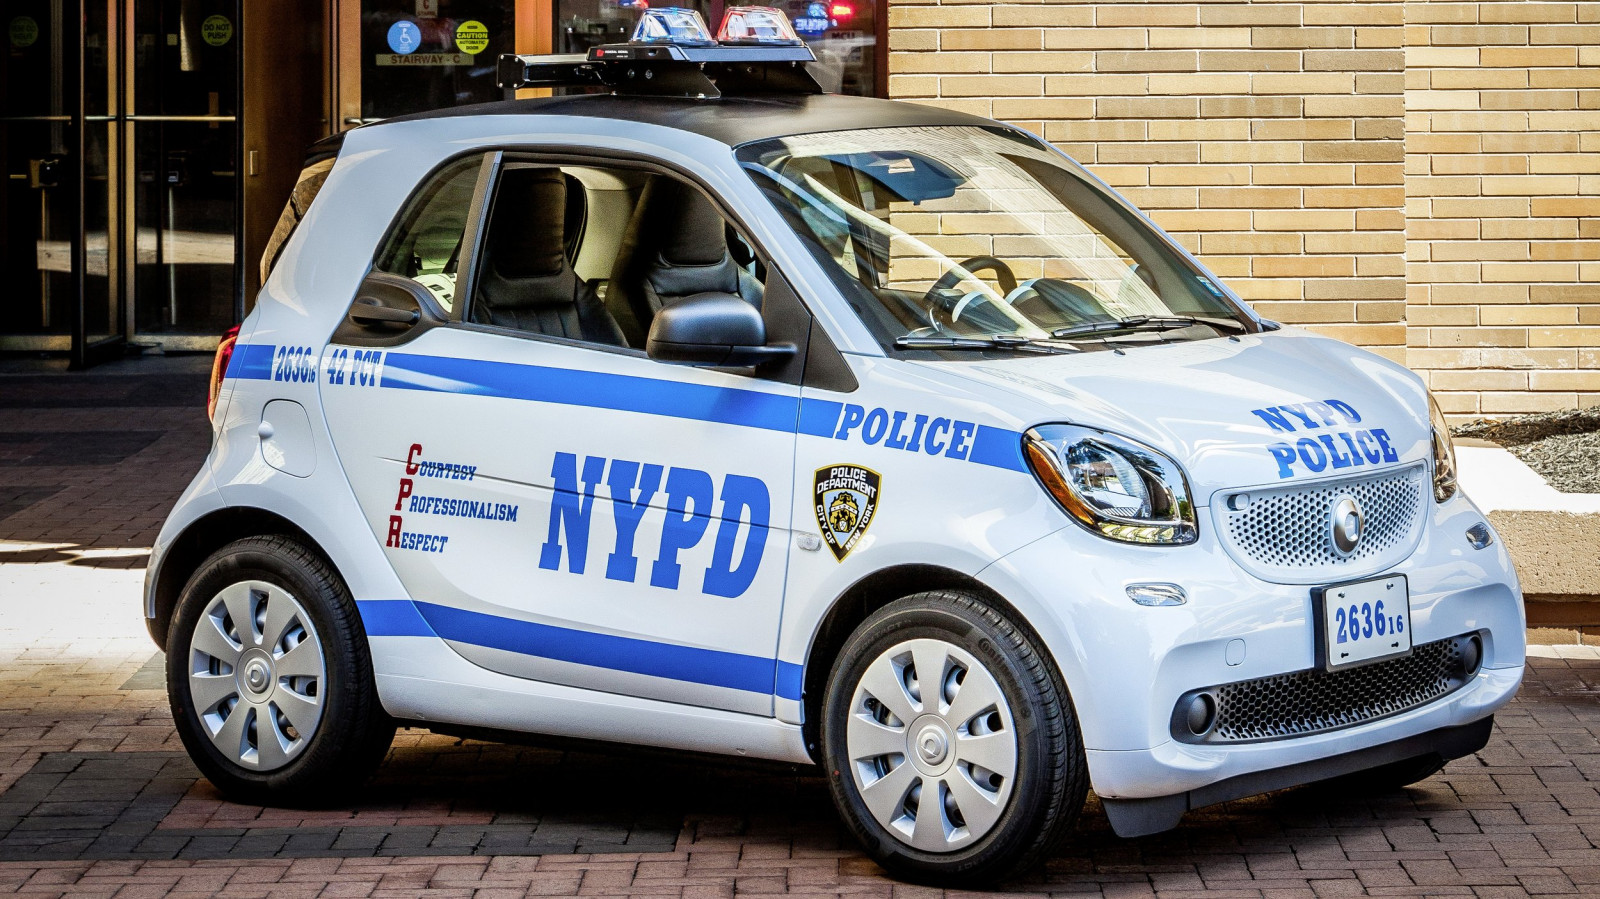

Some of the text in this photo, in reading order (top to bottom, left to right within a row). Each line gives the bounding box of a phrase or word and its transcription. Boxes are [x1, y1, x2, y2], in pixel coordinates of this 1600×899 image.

[391, 55, 443, 64] STAIRWAY
[453, 55, 460, 63] C
[327, 349, 348, 385] 42
[350, 350, 382, 387] PCT
[835, 403, 975, 461] POLICE
[1251, 399, 1362, 435] NYPD
[405, 443, 478, 481] COURTESY
[1267, 428, 1399, 479] POLICE
[817, 478, 876, 498] DEPARTMENT
[830, 467, 867, 481] POLICE
[395, 478, 519, 522] PROFESSIONALISM
[386, 515, 448, 553] RESPECT
[538, 451, 770, 599] NYPD
[816, 504, 836, 545] CITY OF
[845, 504, 874, 551] NEW YORK
